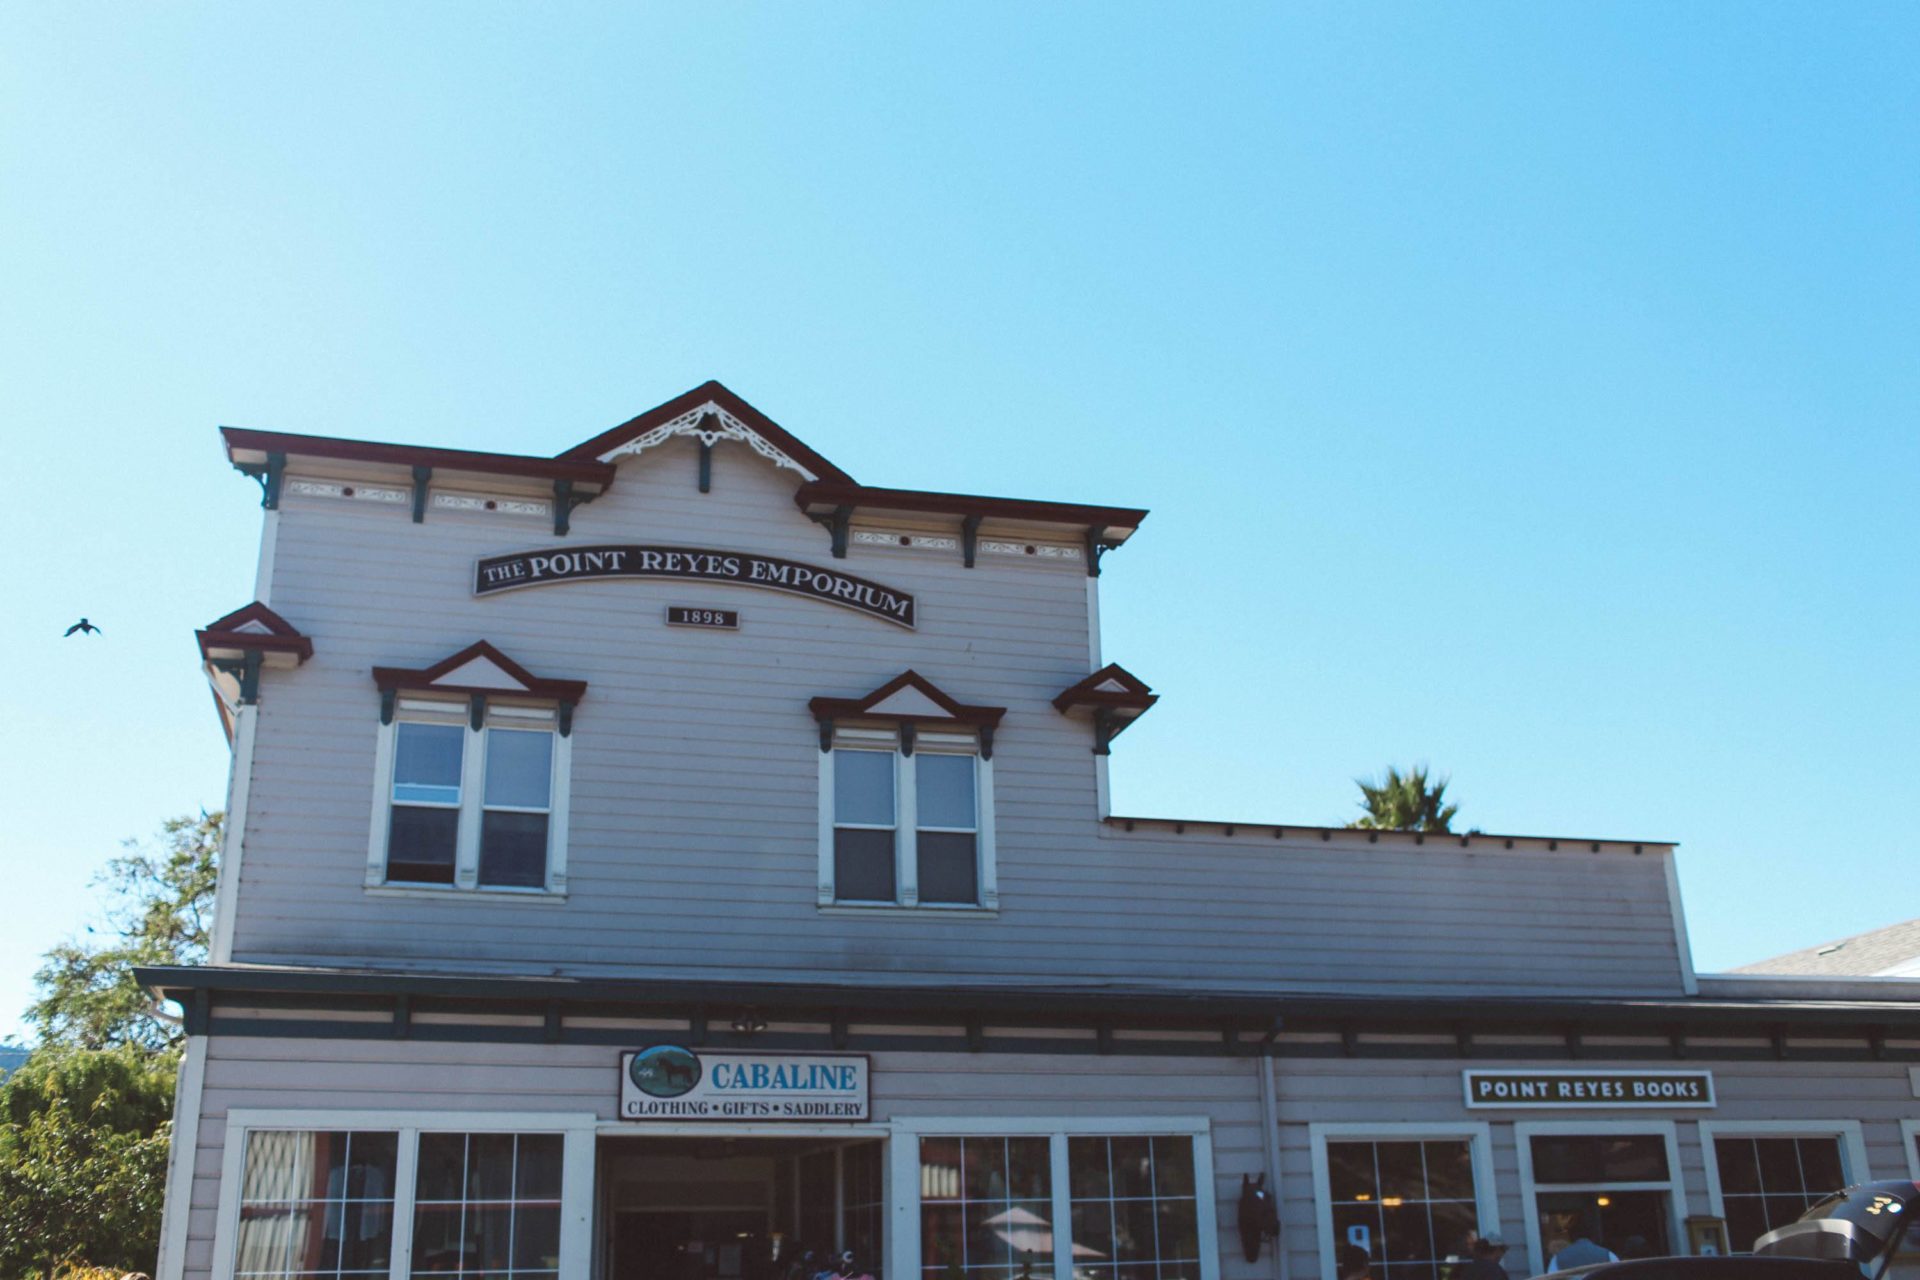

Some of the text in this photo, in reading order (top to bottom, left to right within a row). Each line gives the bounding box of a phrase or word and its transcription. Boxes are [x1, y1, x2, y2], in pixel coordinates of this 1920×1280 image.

[483, 551, 911, 618] THE POINT REYES EMPORIUM
[682, 610, 725, 625] 1898
[712, 1063, 857, 1090] CABALINE
[1479, 1081, 1699, 1097] POINT REYES BOOKS
[627, 1101, 862, 1116] CLOTHING GIFTS SADDLERY
